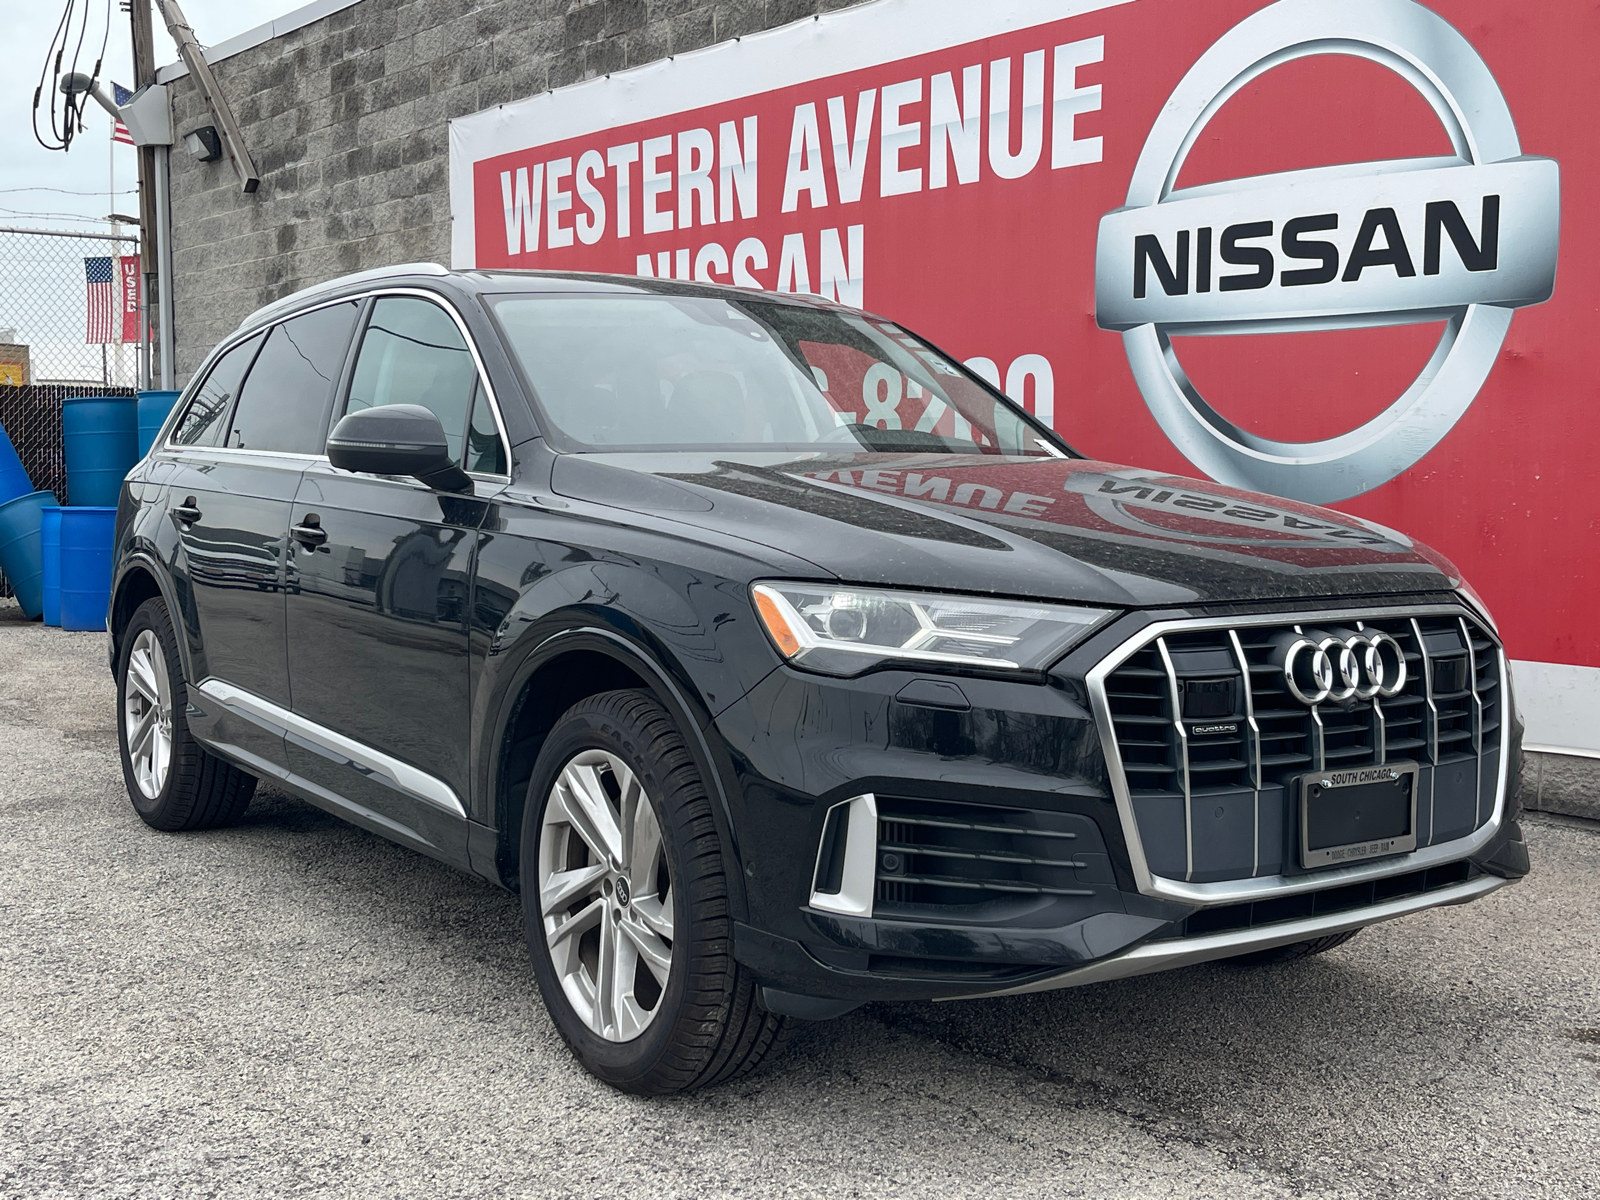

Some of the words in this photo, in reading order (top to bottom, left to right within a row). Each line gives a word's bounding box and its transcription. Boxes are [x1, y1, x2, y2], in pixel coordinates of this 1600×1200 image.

[501, 115, 758, 256] WESTERN
[780, 35, 1104, 213] AVENUE
[636, 224, 864, 310] SAN
[1133, 195, 1500, 299] NISSAN
[124, 263, 137, 313] USED
[600, 722, 657, 789] EAGLE
[1194, 725, 1237, 734] quattro
[1331, 772, 1358, 785] SOUTH
[1360, 768, 1393, 782] CHICAGO
[1369, 843, 1379, 854] JEEP
